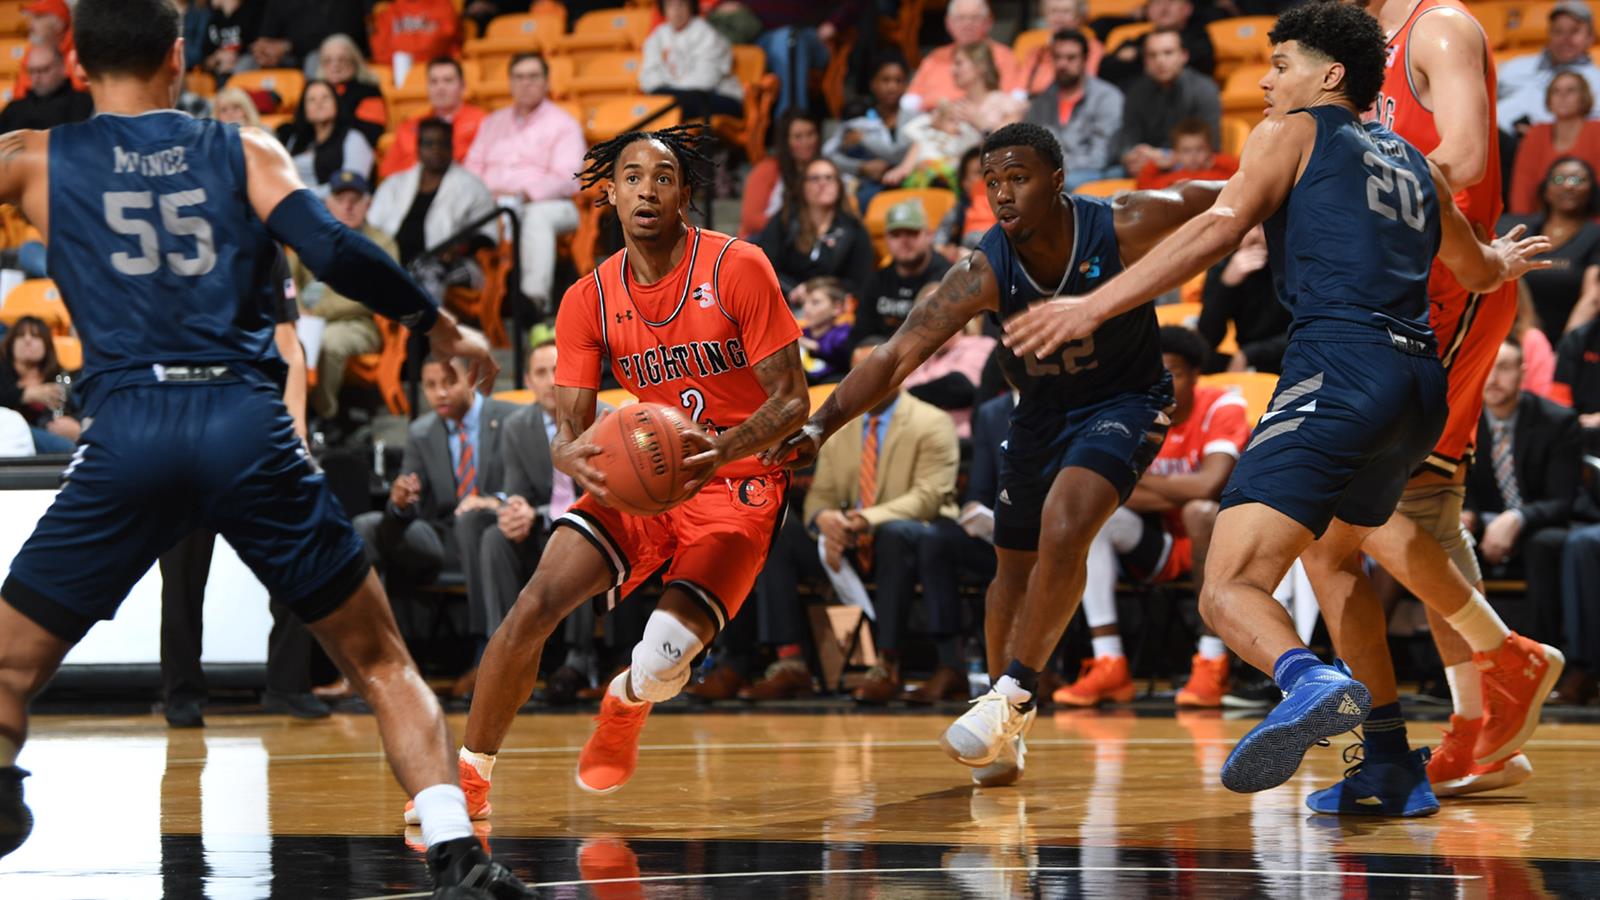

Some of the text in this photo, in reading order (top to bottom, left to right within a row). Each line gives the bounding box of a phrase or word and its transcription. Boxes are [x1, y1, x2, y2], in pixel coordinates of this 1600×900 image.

[1363, 150, 1426, 232] 20
[102, 187, 217, 276] 55
[618, 338, 748, 388] FIGHTING
[678, 386, 706, 425] 2
